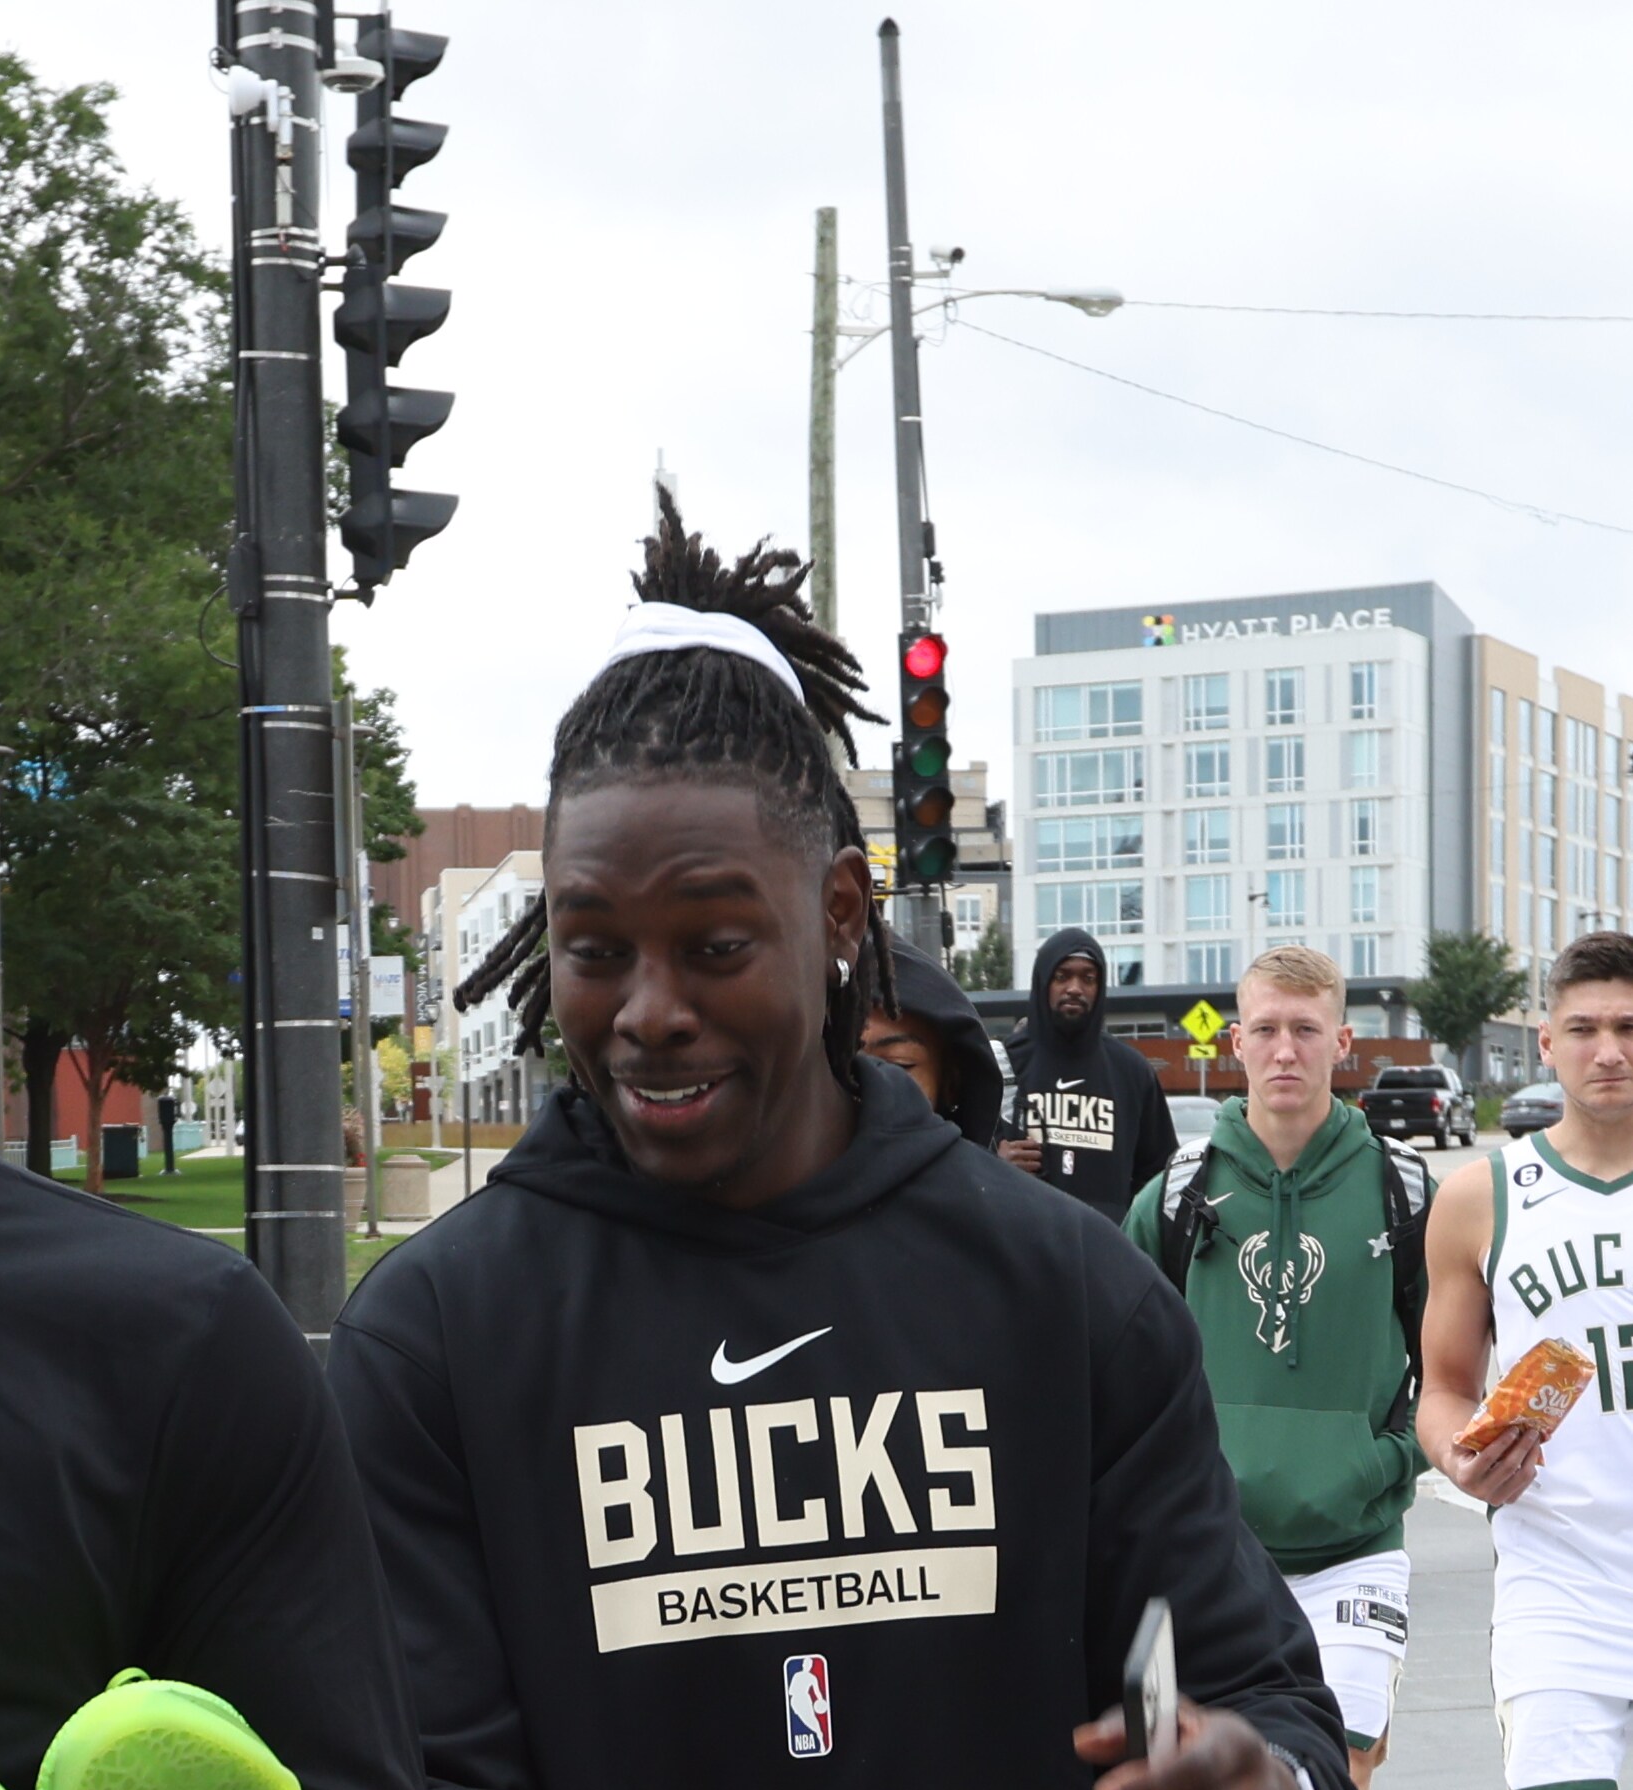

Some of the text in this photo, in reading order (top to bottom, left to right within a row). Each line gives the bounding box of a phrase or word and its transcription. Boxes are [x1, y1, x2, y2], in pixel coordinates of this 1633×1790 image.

[1182, 608, 1392, 643] HYATT PLACE
[1027, 1092, 1114, 1132] BUCKS
[1047, 1131, 1099, 1145] ASKETBALL
[1520, 1166, 1538, 1187] 6
[574, 1388, 996, 1569] BUCKS
[657, 1566, 941, 1627] BASKETBALL
[795, 1733, 816, 1751] NBA
